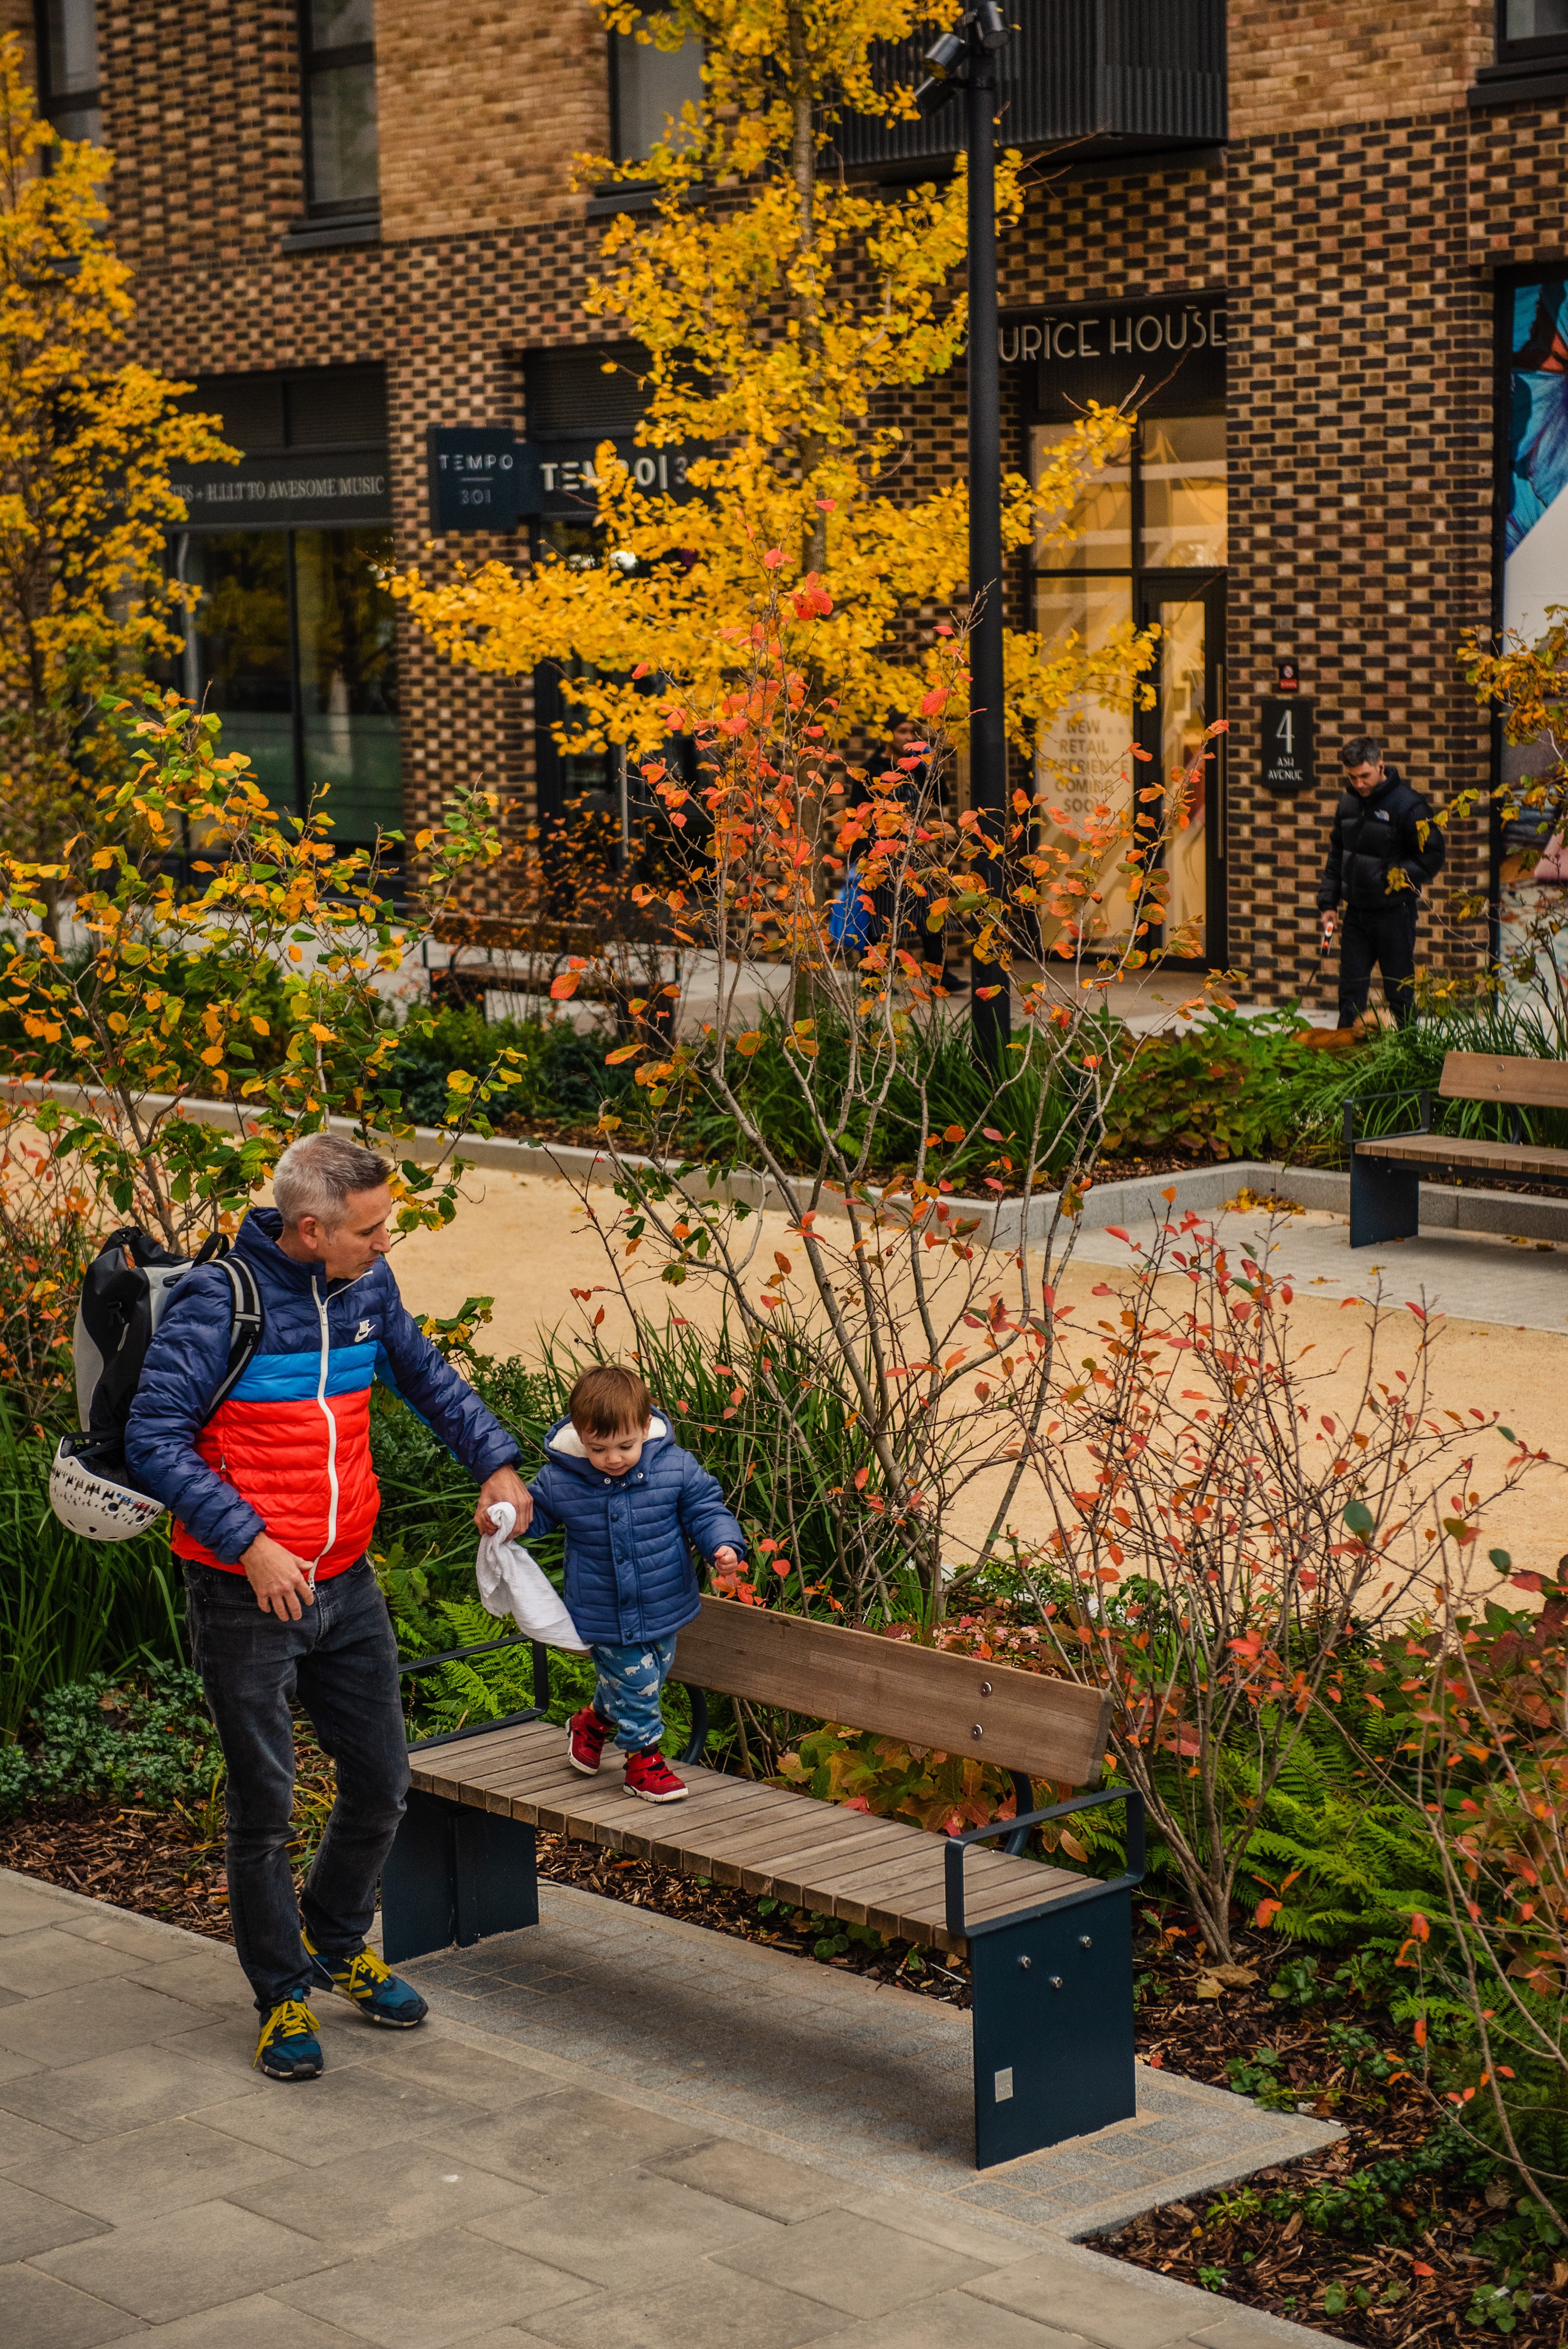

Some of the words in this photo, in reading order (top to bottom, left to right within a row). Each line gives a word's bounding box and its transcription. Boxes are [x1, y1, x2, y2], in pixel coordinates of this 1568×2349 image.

[998, 319, 1100, 362] URICE
[1110, 309, 1228, 353] HOUSE
[438, 453, 514, 471] TEMPO
[247, 481, 266, 500] TO
[268, 478, 337, 499] AWESOME
[338, 475, 385, 496] MUSIC
[459, 489, 492, 505] 301
[1066, 719, 1100, 734] NEW
[1276, 709, 1295, 754] 4
[1059, 738, 1109, 754] RETAIL
[1277, 756, 1294, 768] ASH
[1268, 769, 1303, 781] AVENUE
[1055, 778, 1115, 793] COMING
[1064, 798, 1099, 813] SOO
[359, 1319, 370, 1334] NIKE
